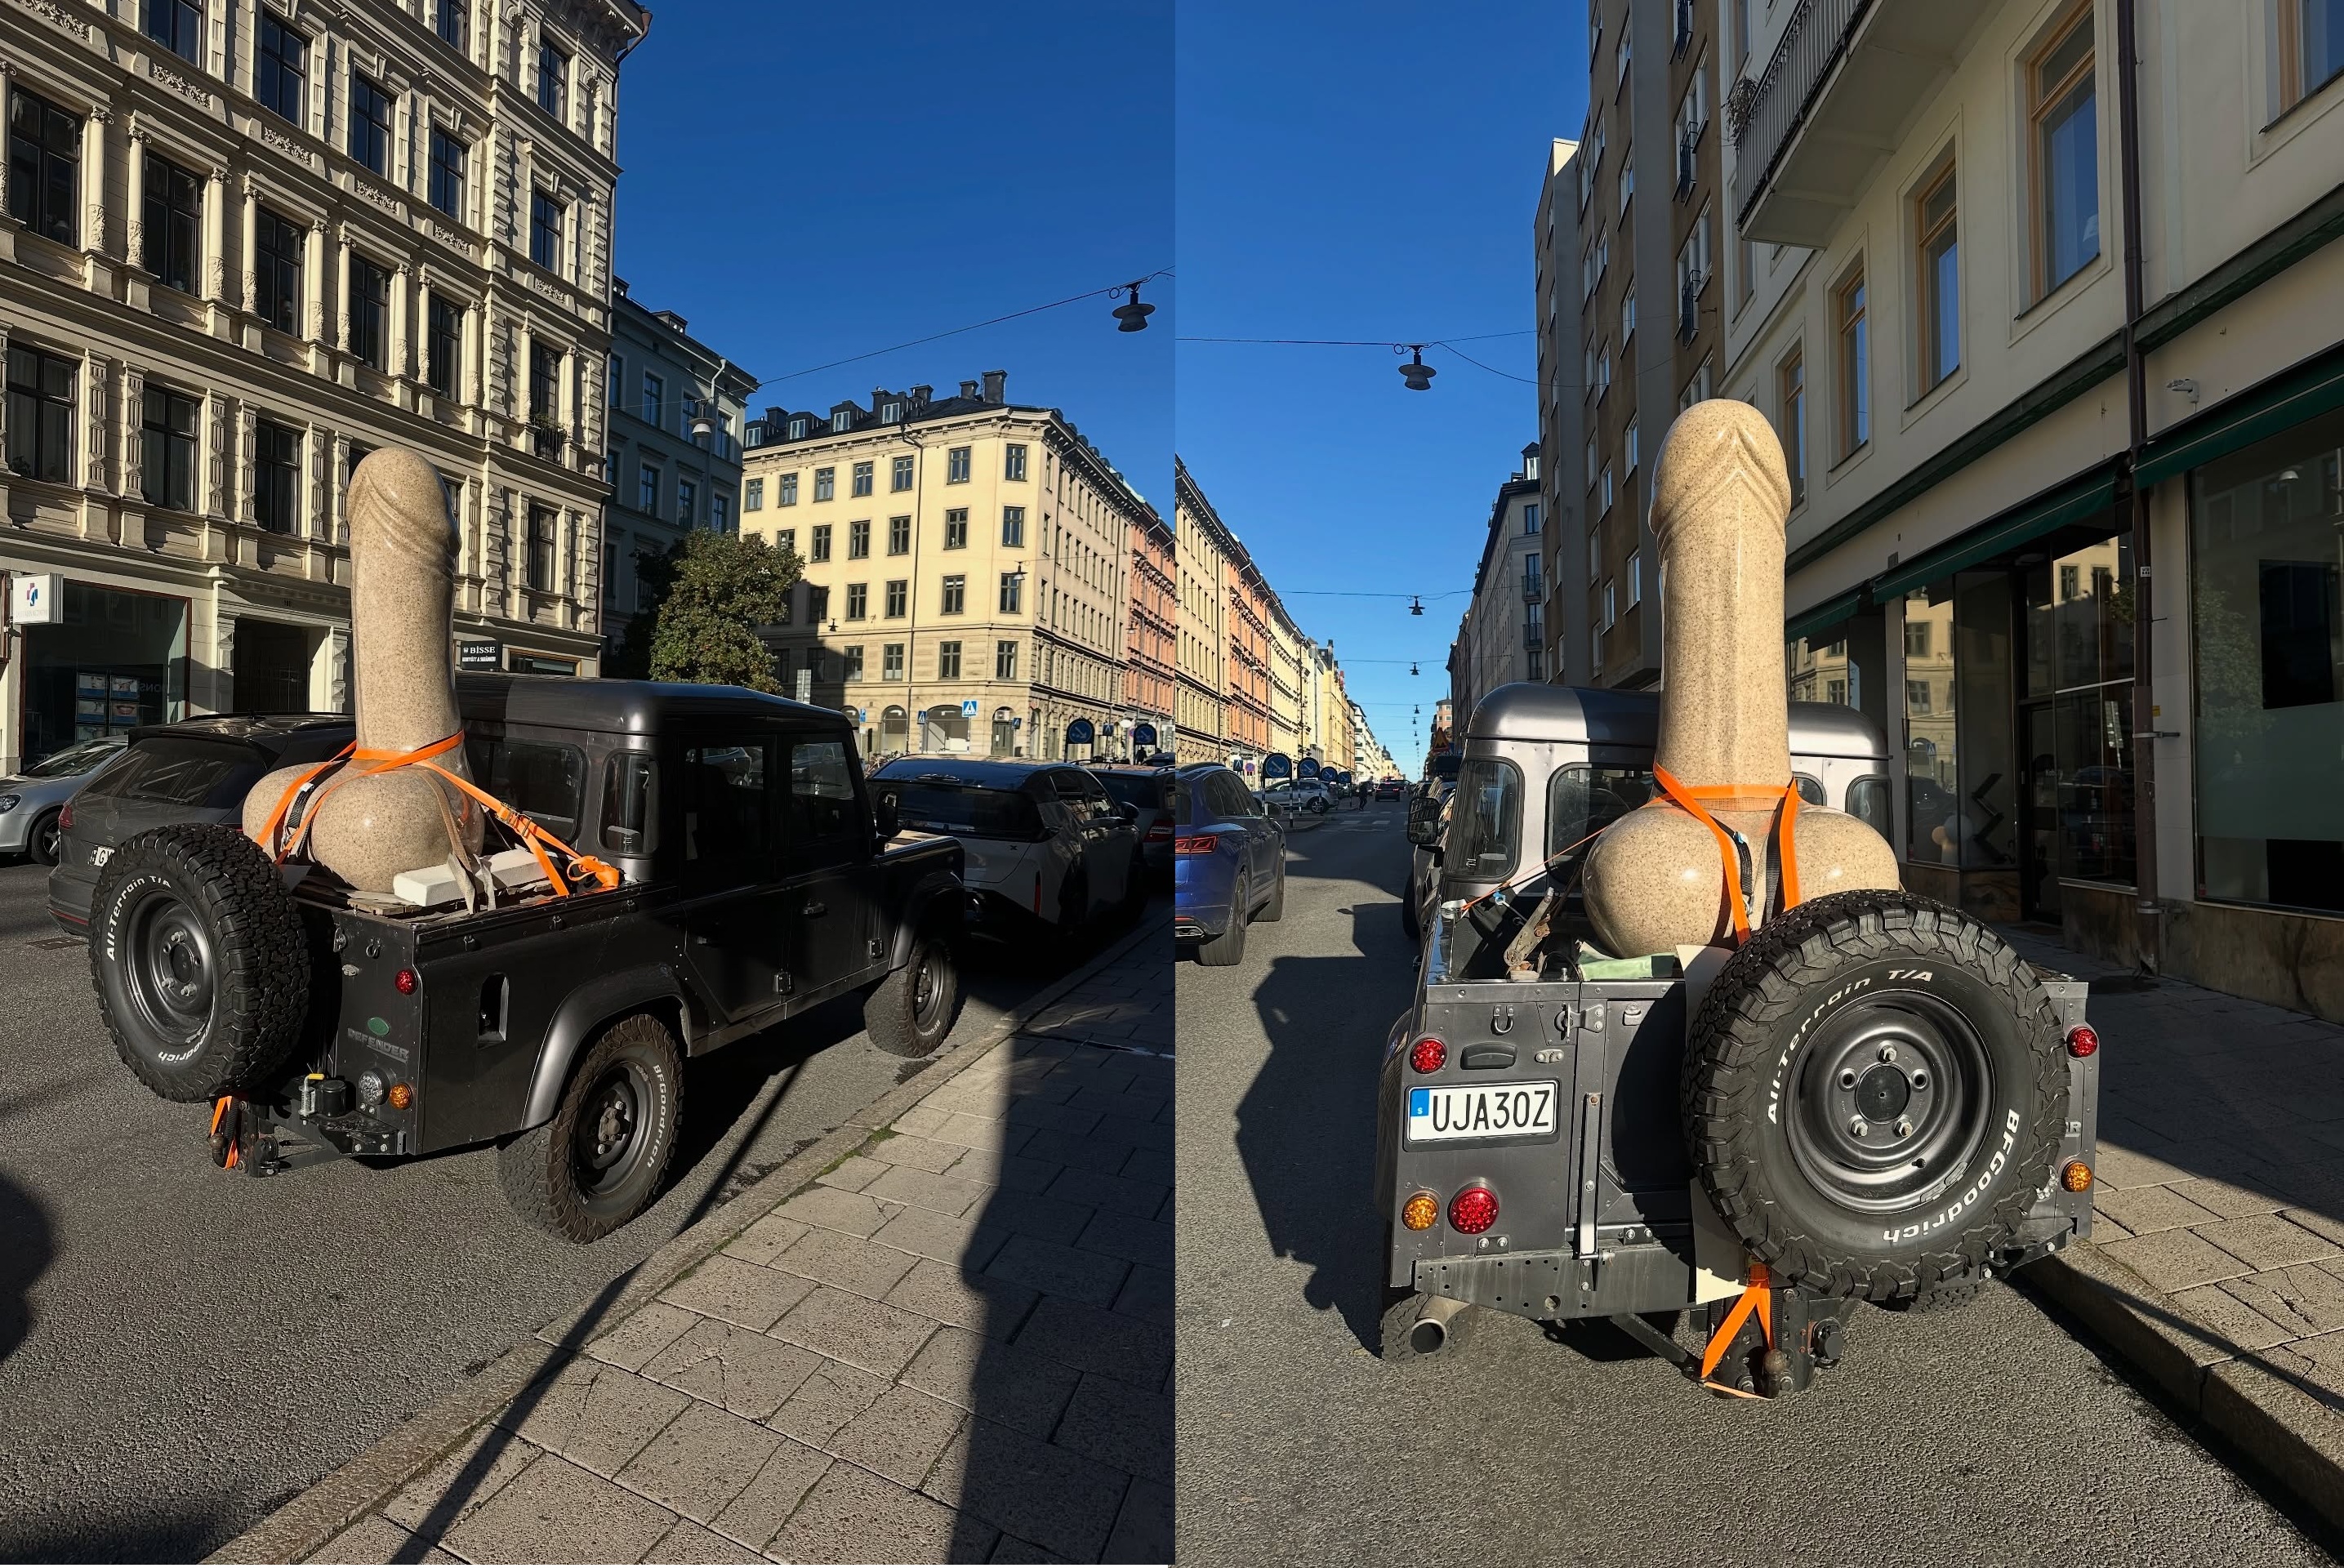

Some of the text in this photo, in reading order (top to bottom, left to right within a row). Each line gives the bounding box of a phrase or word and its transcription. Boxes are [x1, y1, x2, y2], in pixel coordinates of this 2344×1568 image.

[106, 877, 145, 961] All-Terrain
[347, 1027, 410, 1059] DEFENDER
[1767, 969, 1933, 1125] All-Terrain T/A
[647, 1063, 666, 1169] BFGoodrich
[1433, 1089, 1550, 1132] UJA30Z
[1883, 1108, 2020, 1243] BFGoodrich
